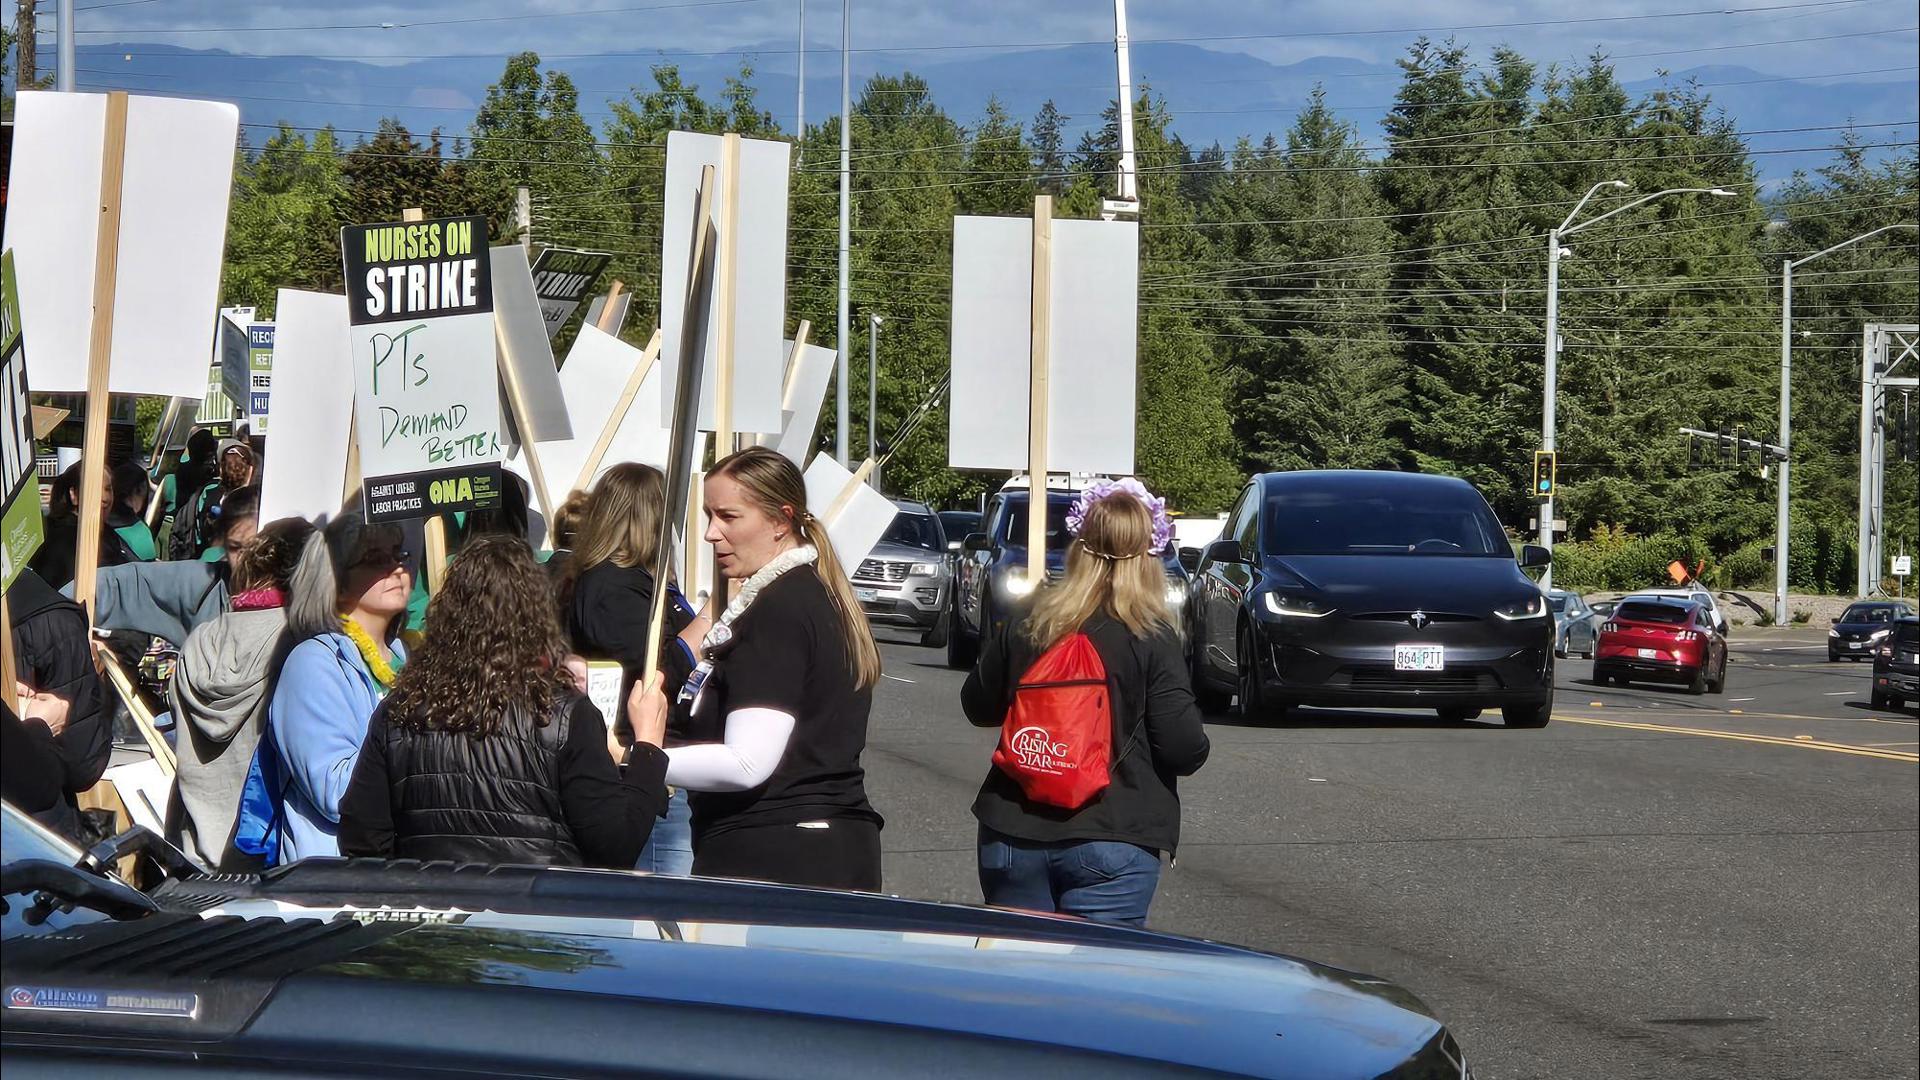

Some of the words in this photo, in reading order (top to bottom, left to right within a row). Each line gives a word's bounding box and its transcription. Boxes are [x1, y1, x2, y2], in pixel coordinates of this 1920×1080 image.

[365, 223, 441, 263] NURSES
[446, 221, 472, 256] ON
[366, 258, 477, 317] STRIKE
[369, 323, 429, 396] PTs
[371, 499, 392, 515] LABOR
[392, 497, 422, 512] PRACTICES
[429, 477, 474, 505] ONA
[1397, 651, 1417, 664] 864
[1422, 651, 1442, 665] PTT
[1011, 726, 1068, 758] RISING
[1018, 747, 1052, 769] STAR
